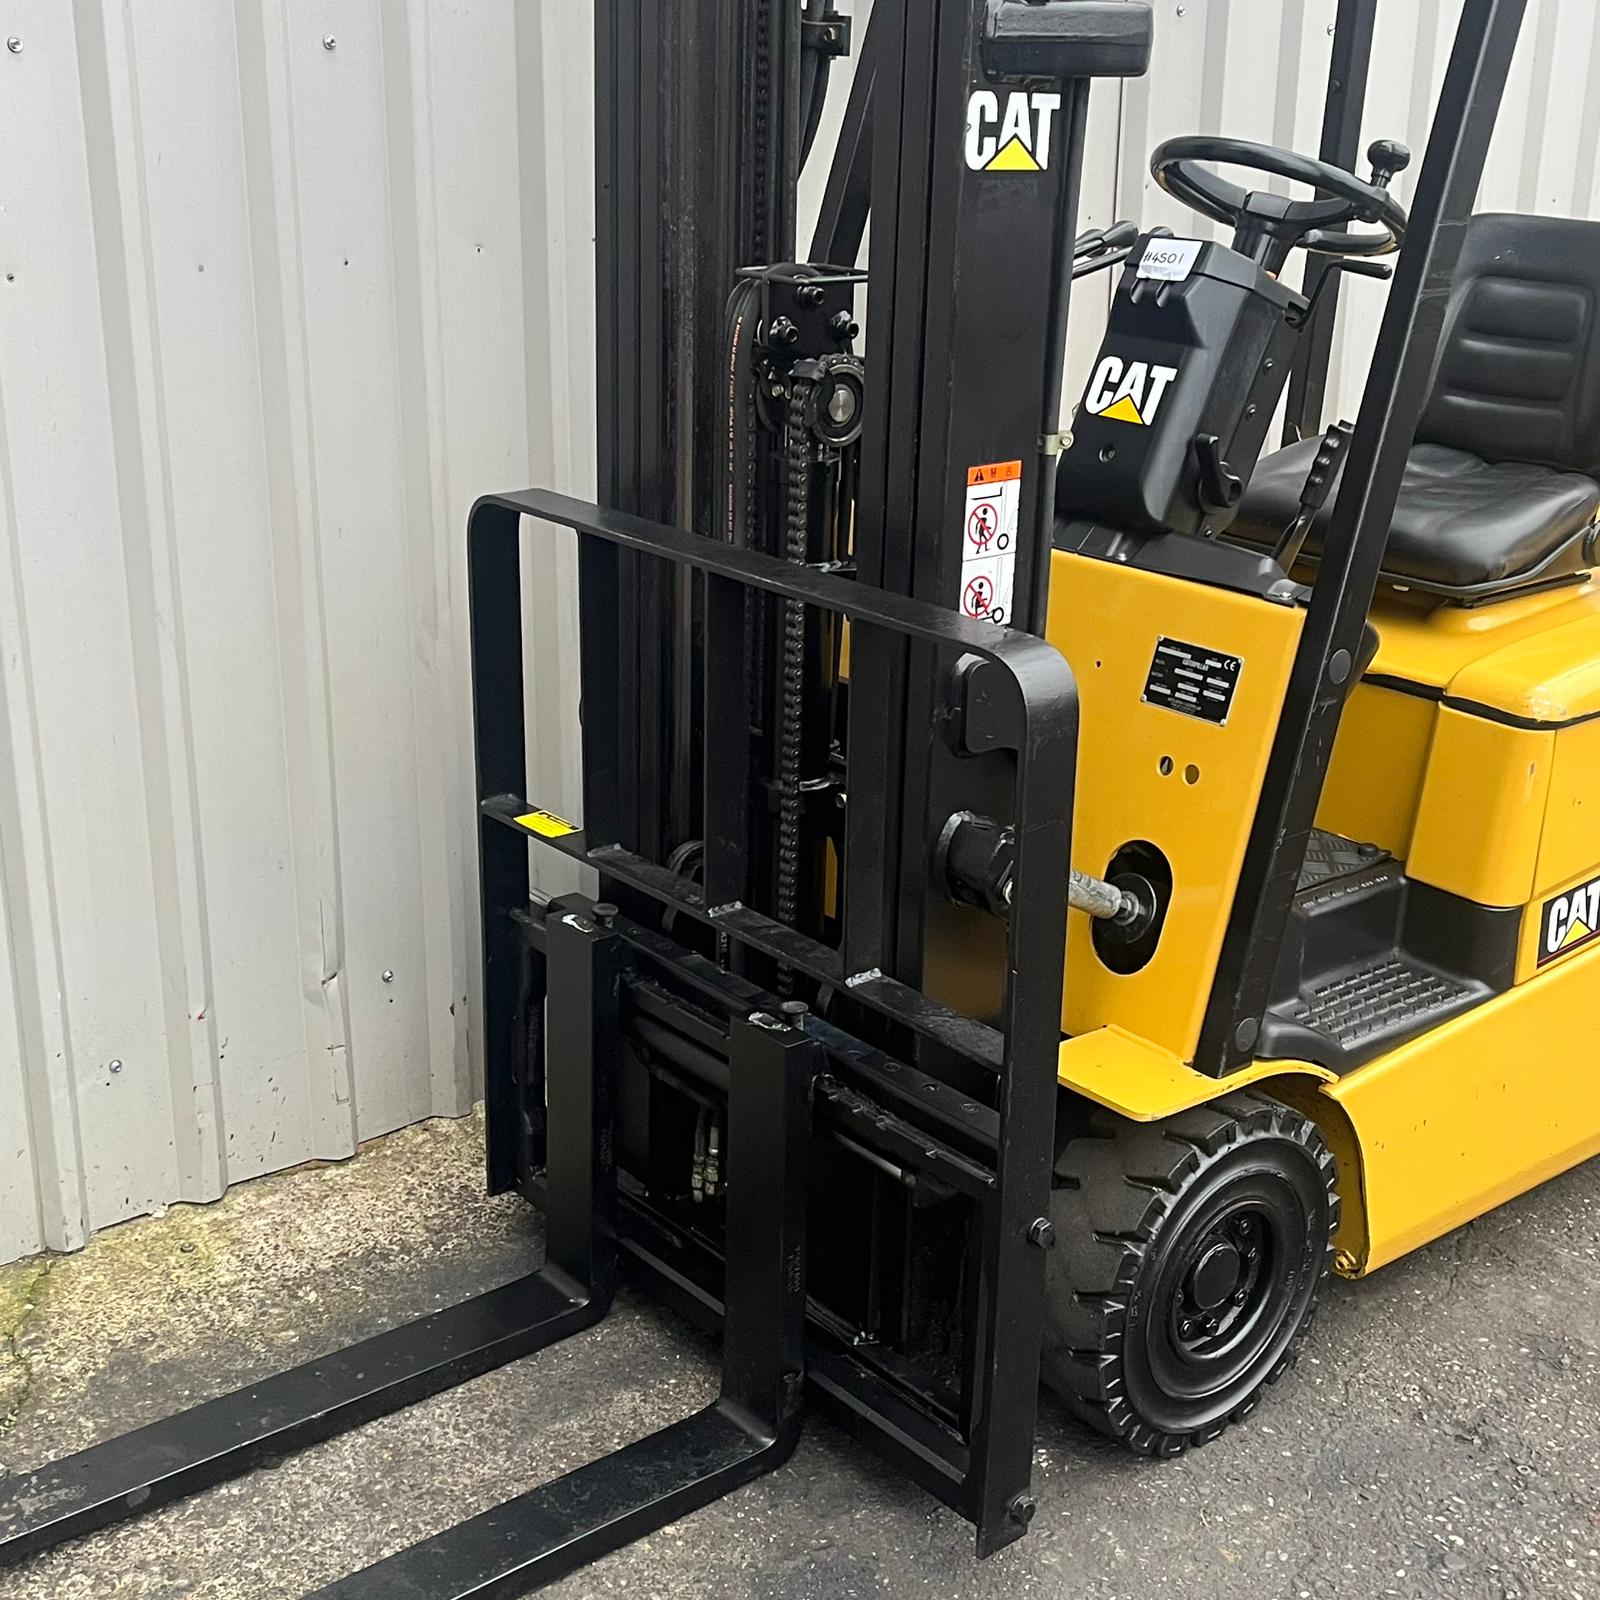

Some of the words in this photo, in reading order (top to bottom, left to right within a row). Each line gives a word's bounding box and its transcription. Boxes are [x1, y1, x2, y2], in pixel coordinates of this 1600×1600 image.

[965, 90, 1061, 171] CAT
[1085, 355, 1178, 426] CAT
[1546, 879, 1600, 953] CAT
